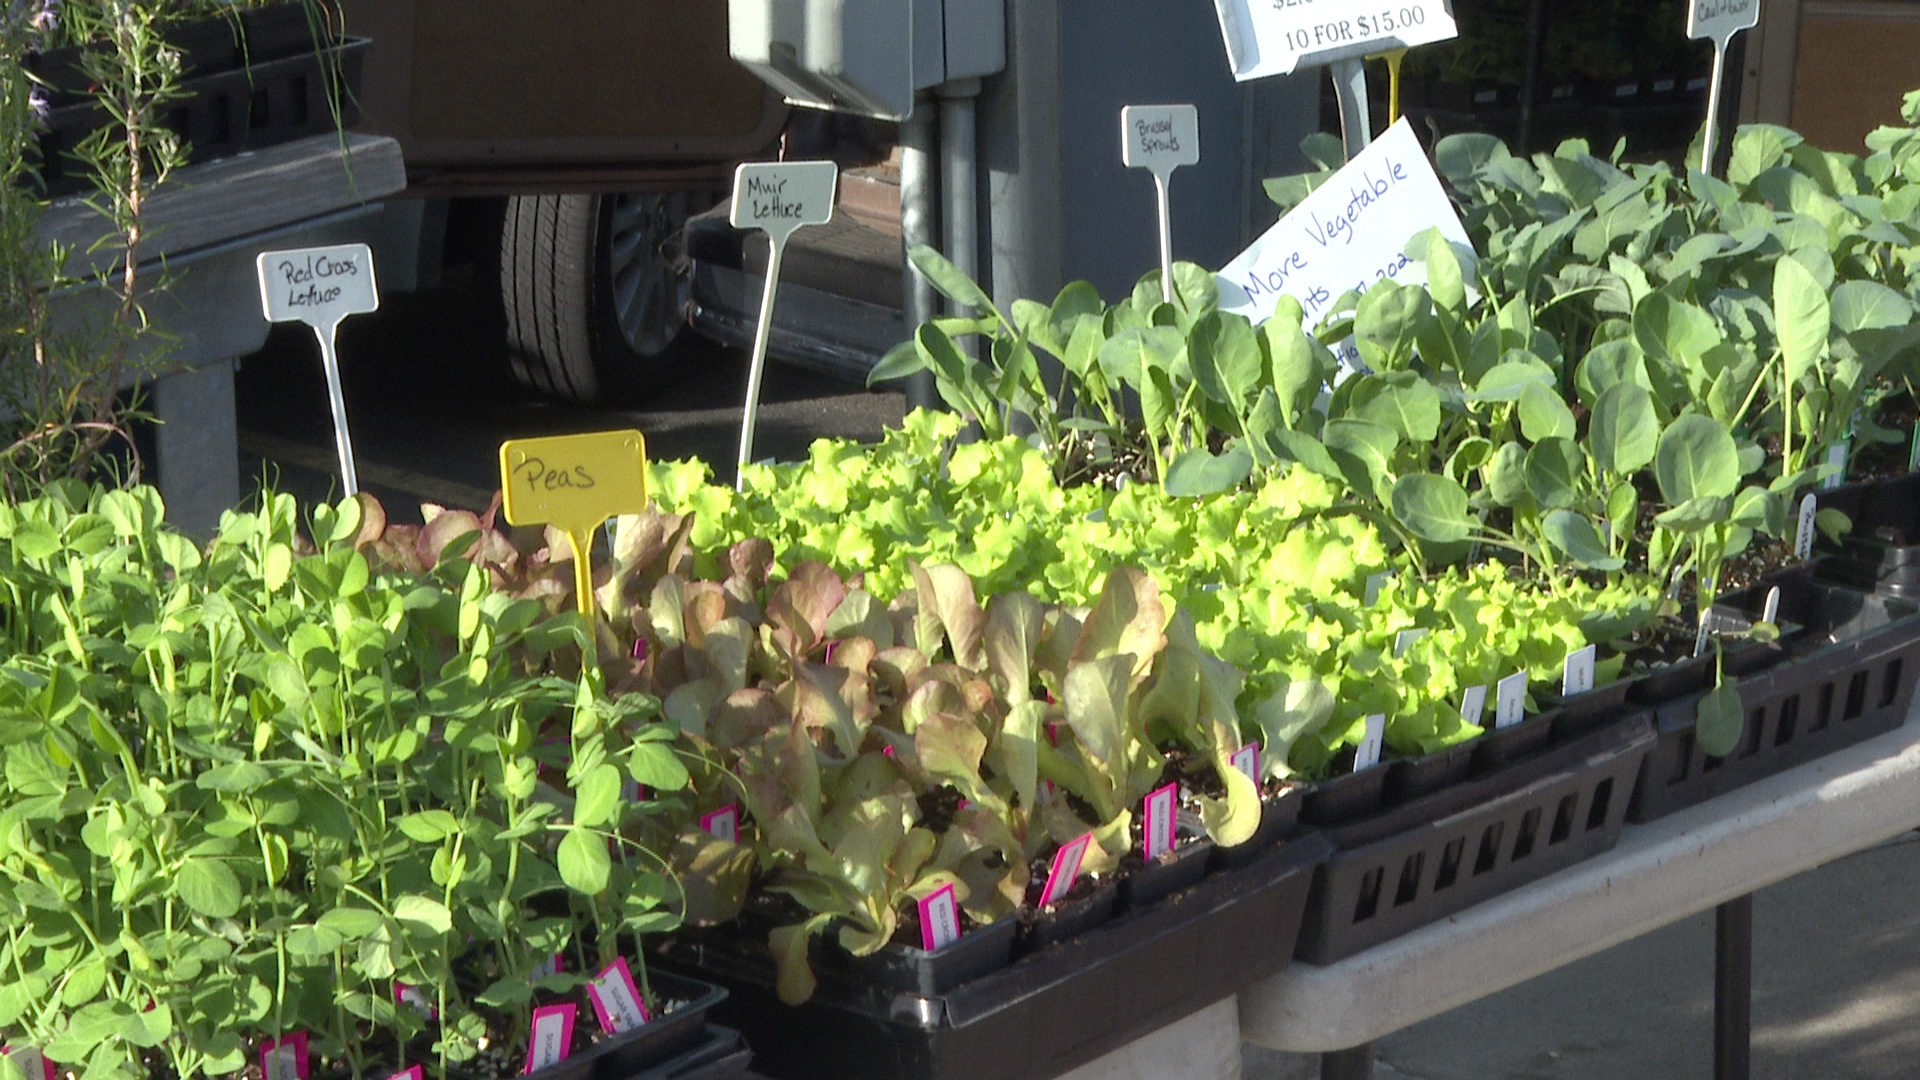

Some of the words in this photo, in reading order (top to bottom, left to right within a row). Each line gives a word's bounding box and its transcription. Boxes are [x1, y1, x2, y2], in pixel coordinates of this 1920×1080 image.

[1284, 29, 1309, 51] 10
[1314, 20, 1354, 46] FOR
[1357, 6, 1425, 38] $15.00
[747, 174, 788, 198] Muir
[753, 195, 803, 219] Lettuce
[1242, 252, 1308, 307] More
[1305, 157, 1408, 246] Vegetable
[278, 255, 314, 285] Red
[513, 457, 595, 492] Peas
